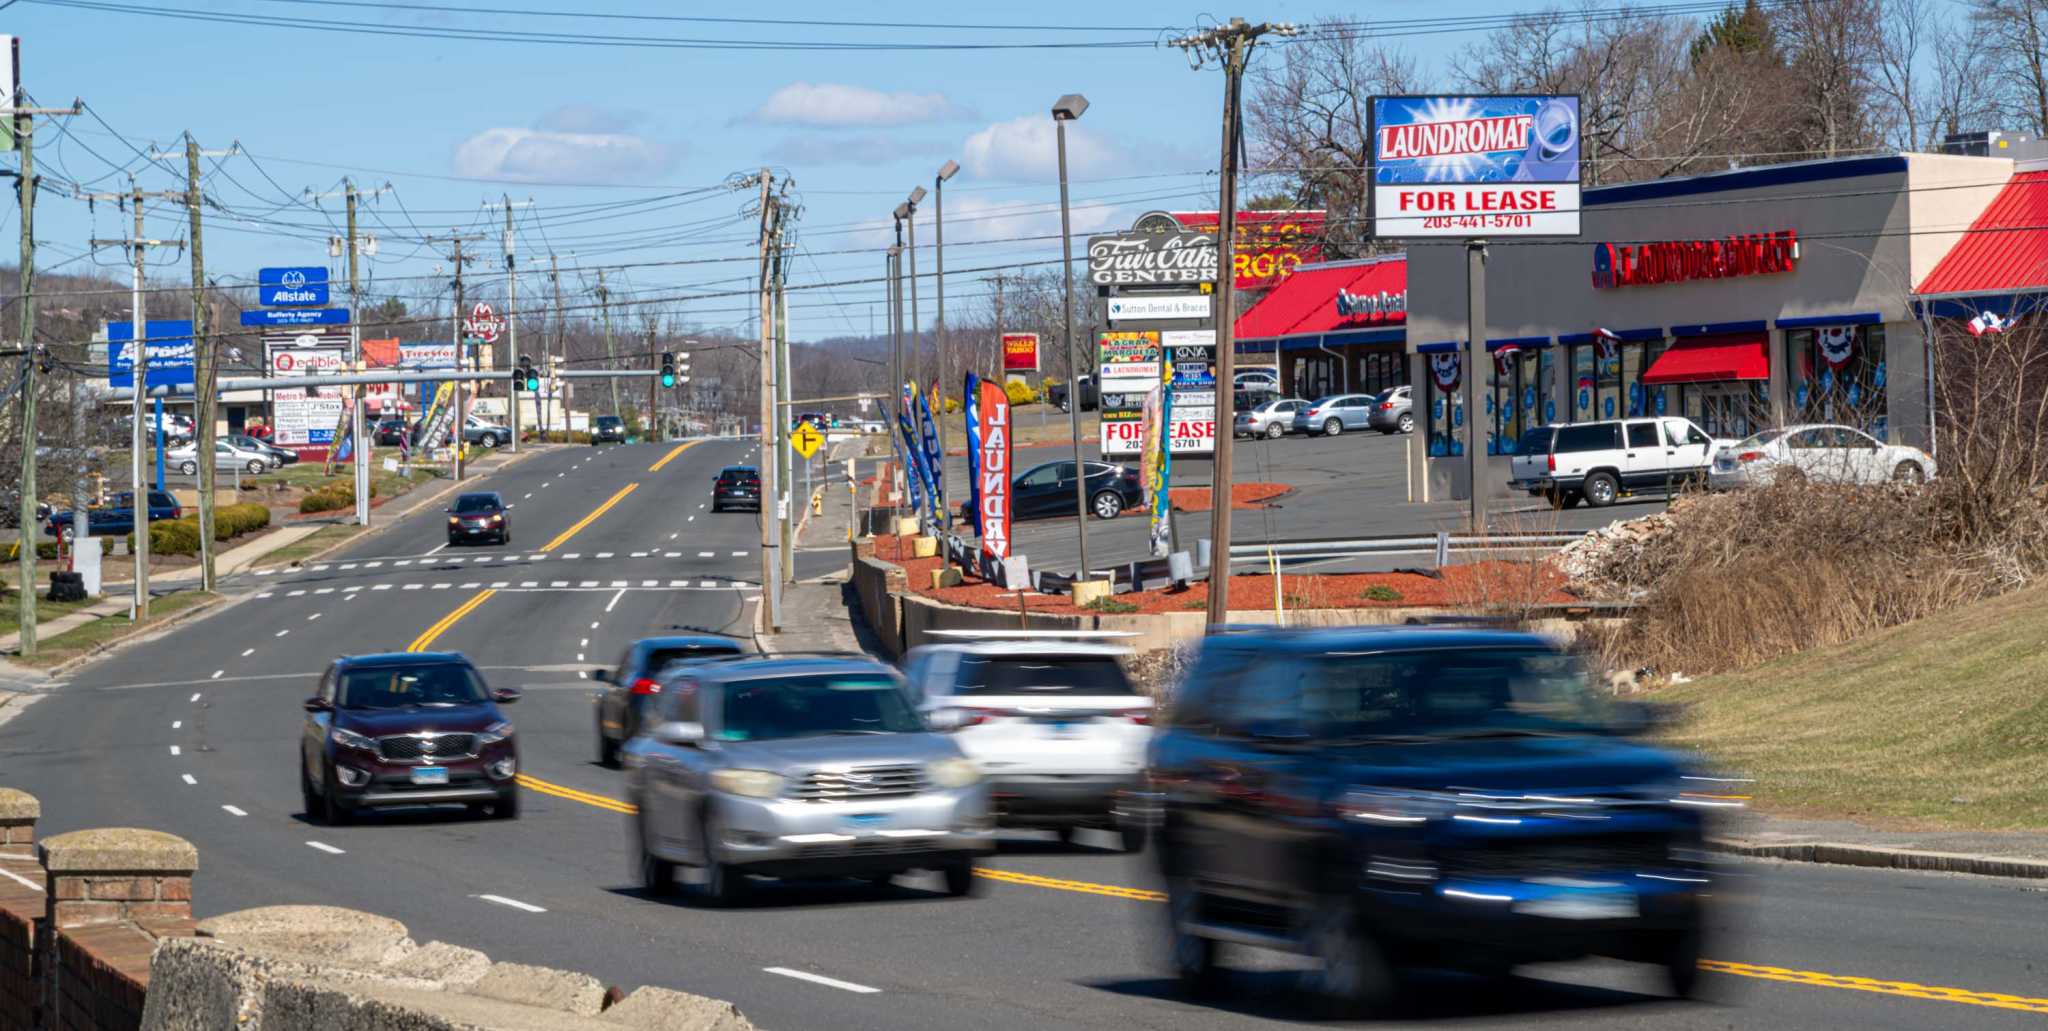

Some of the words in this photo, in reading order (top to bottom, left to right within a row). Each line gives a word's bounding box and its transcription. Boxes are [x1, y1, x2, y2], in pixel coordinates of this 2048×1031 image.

[1381, 117, 1531, 158] LAUNDROMAT
[1400, 191, 1455, 211] FOR
[1465, 190, 1556, 210] LEASE
[1424, 214, 1532, 229] 203-441-5701
[1090, 238, 1155, 271] Fair
[1093, 268, 1218, 284] CENTER
[272, 290, 317, 302] Allstate
[1121, 303, 1146, 313] Sutton
[1149, 303, 1173, 313] Dental
[1175, 303, 1180, 312] &
[1182, 302, 1208, 312] Braces
[462, 319, 507, 334] Arby's
[296, 356, 340, 369] edible
[1169, 421, 1217, 439] EASE
